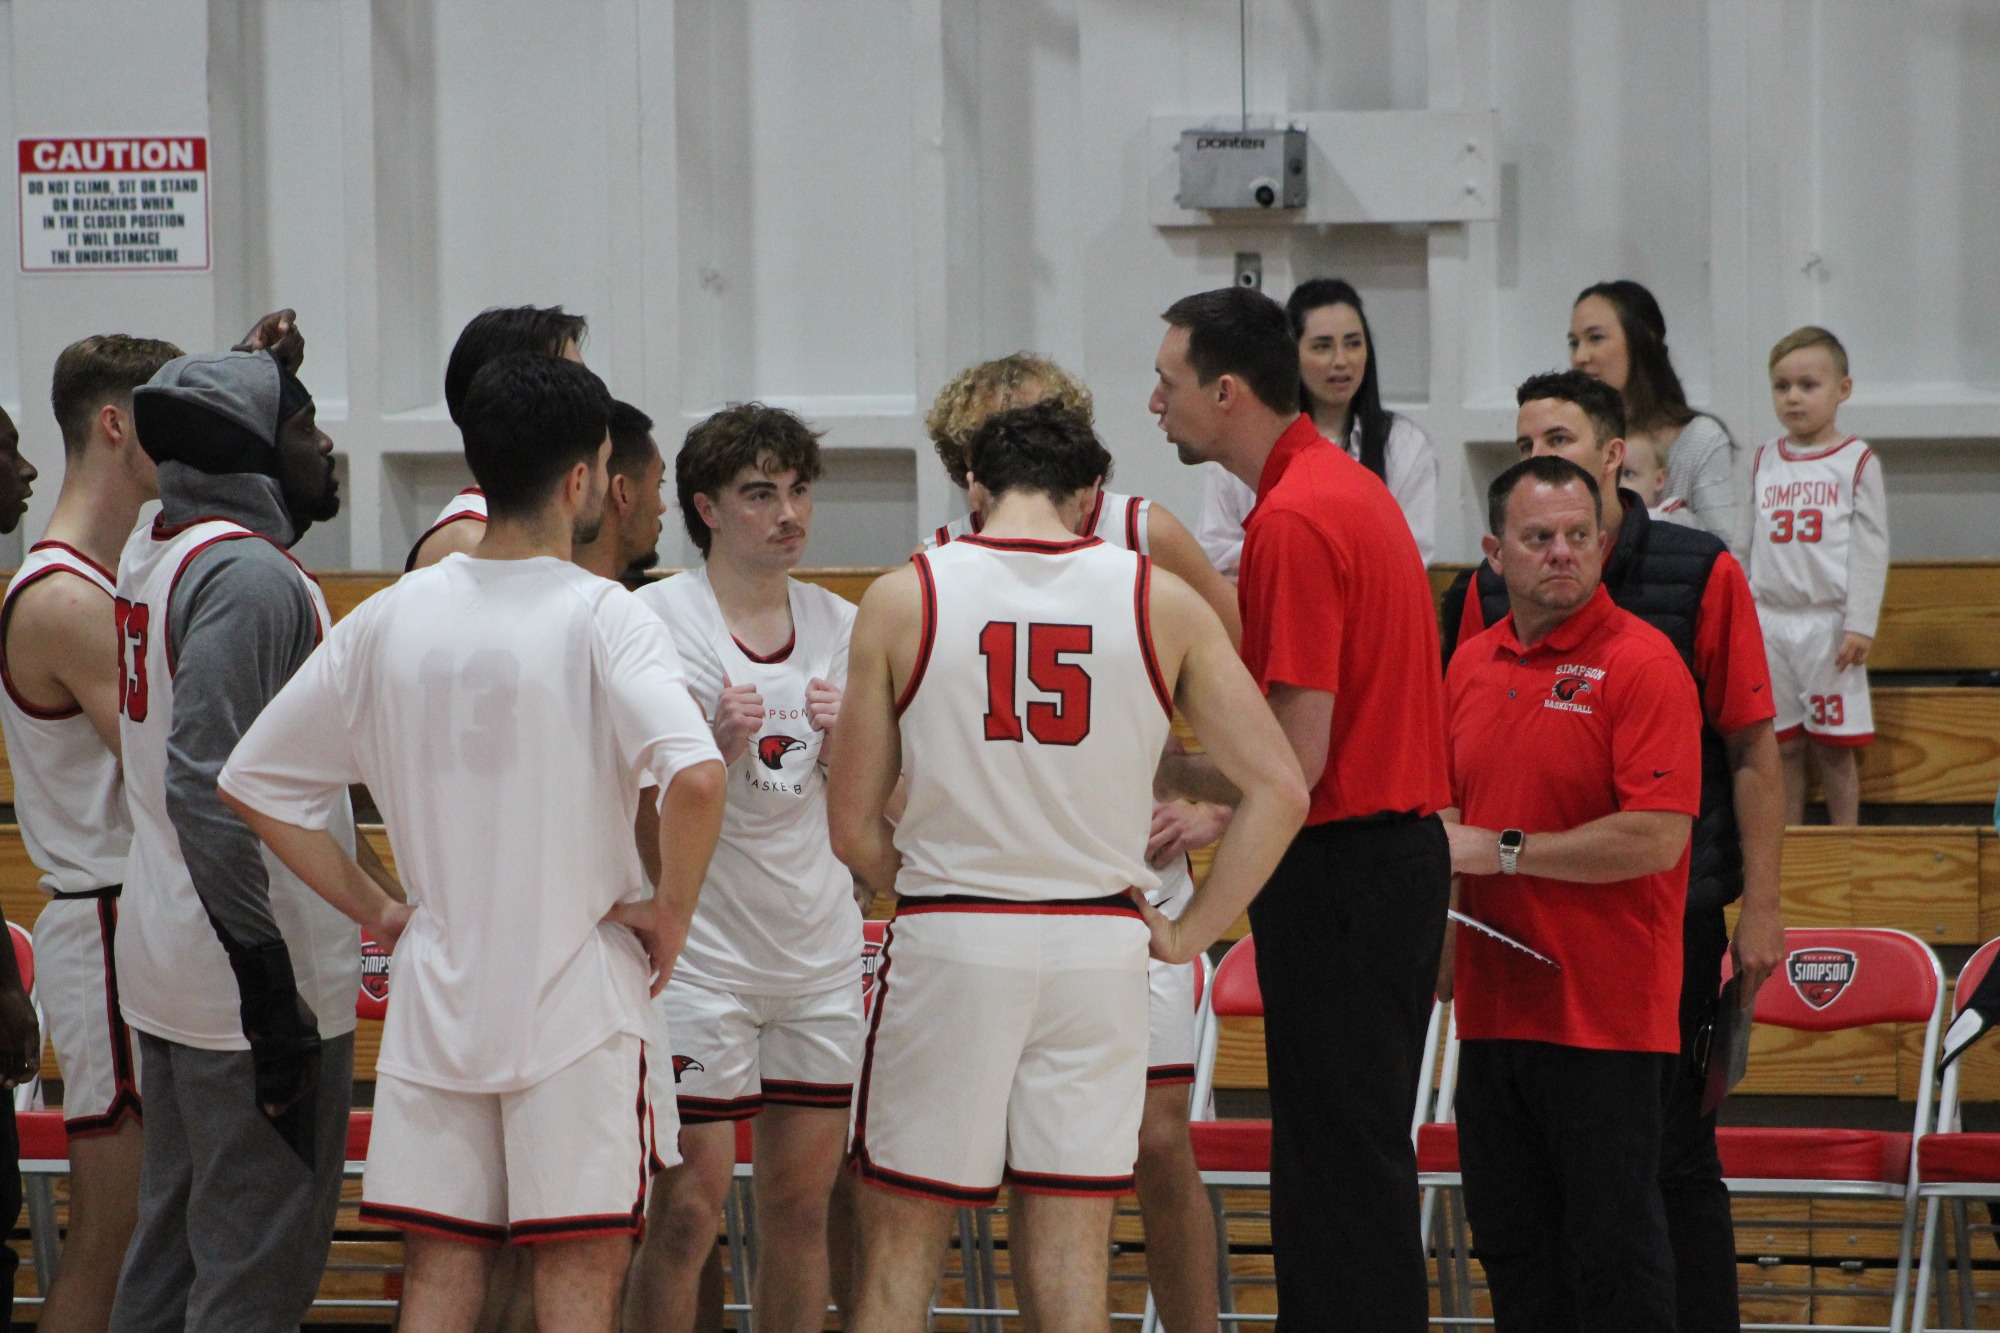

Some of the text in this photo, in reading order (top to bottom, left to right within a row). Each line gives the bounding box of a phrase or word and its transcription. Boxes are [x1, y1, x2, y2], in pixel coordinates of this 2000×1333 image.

[33, 141, 194, 170] CAUTION
[28, 180, 44, 195] DO
[48, 180, 69, 194] NOT
[118, 179, 136, 193] SIT
[141, 178, 157, 193] OR
[160, 178, 198, 193] STAND
[53, 197, 174, 211] ON BLEACHERS WHEN
[43, 214, 185, 229] IN THE CLOSED POSITION
[68, 232, 160, 246] IT WILL DAMAGE
[52, 249, 178, 264] THE UNDERSTRUCTURE
[1762, 481, 1840, 509] SIMPSON
[1770, 509, 1823, 543] 33
[1555, 664, 1606, 681] SIMPSON
[979, 621, 1092, 746] 15
[1543, 699, 1592, 714] BASKETBALL
[1810, 694, 1844, 727] 33
[361, 956, 391, 973] SIMPS
[1794, 963, 1848, 981] SIMPSON
